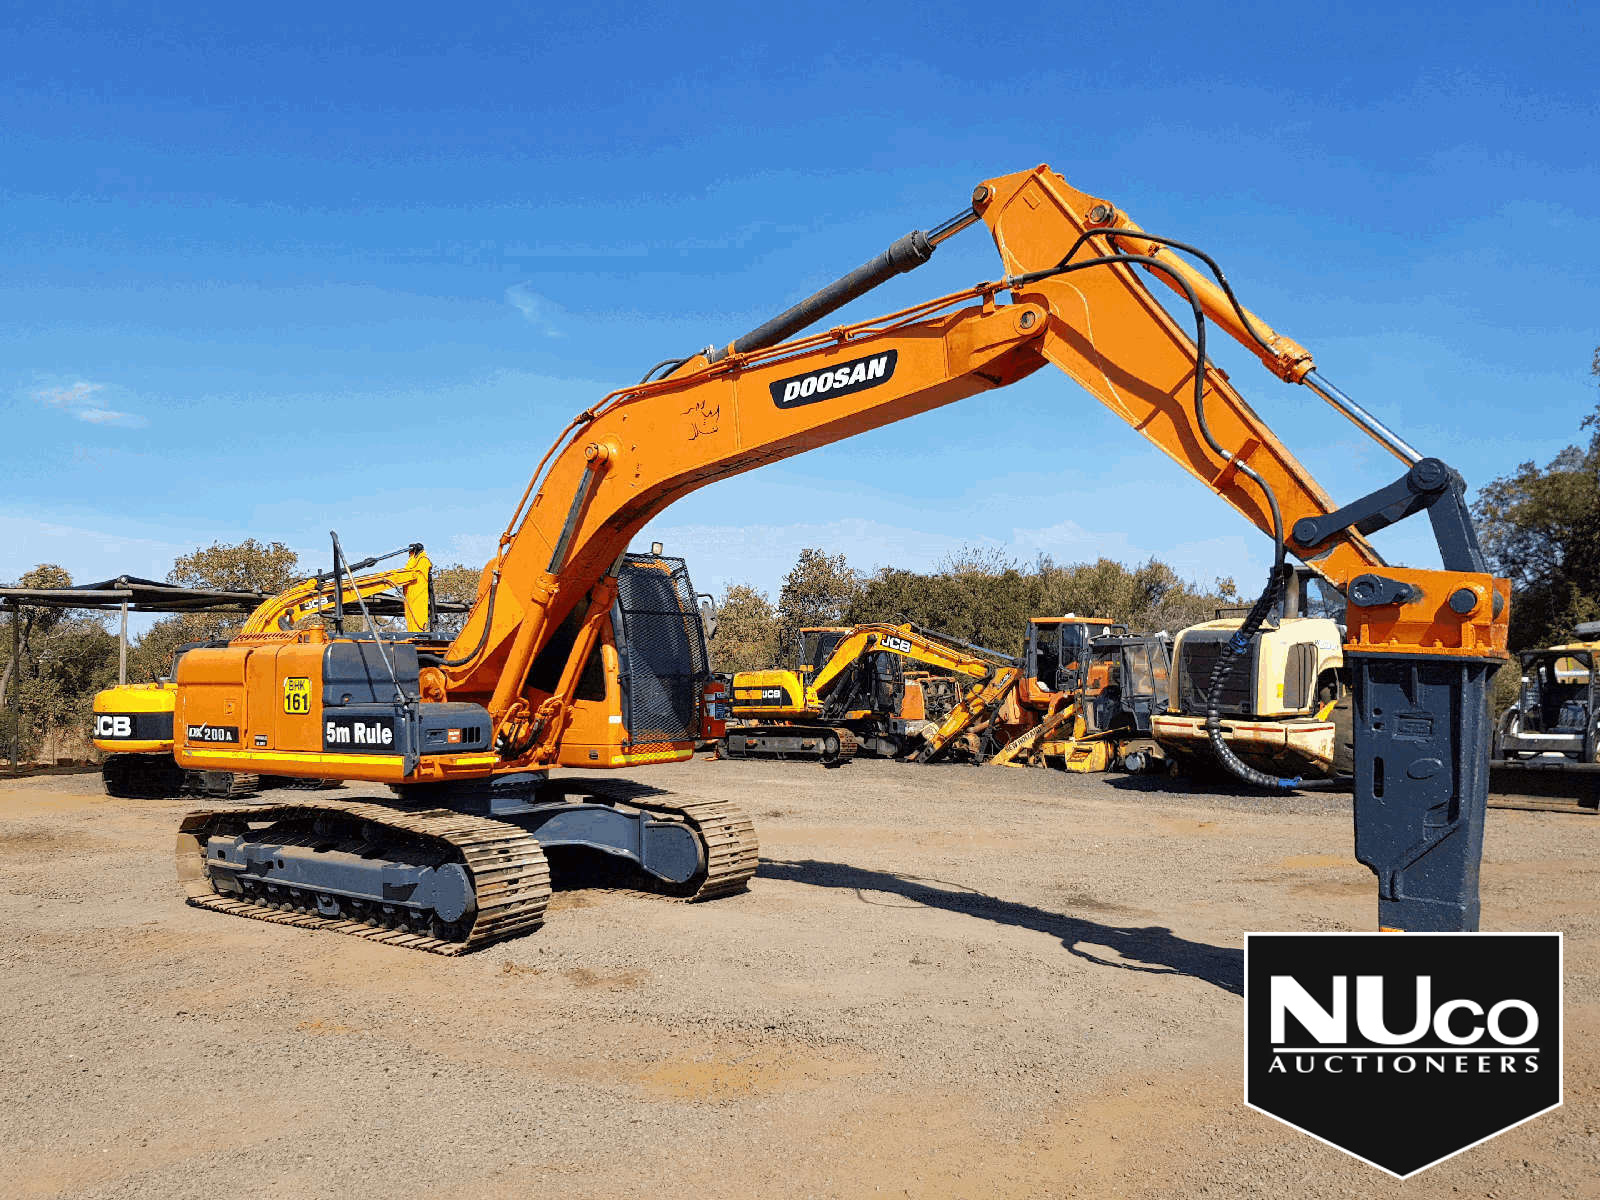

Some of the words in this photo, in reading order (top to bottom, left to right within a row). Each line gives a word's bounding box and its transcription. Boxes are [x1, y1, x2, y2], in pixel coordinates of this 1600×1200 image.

[783, 356, 888, 403] DOOSAN
[882, 635, 911, 653] JCB
[289, 679, 305, 690] BHK
[286, 693, 308, 710] 161
[762, 689, 781, 699] JCB
[94, 715, 132, 736] JCB
[326, 721, 350, 743] 5m
[354, 722, 393, 745] Rule
